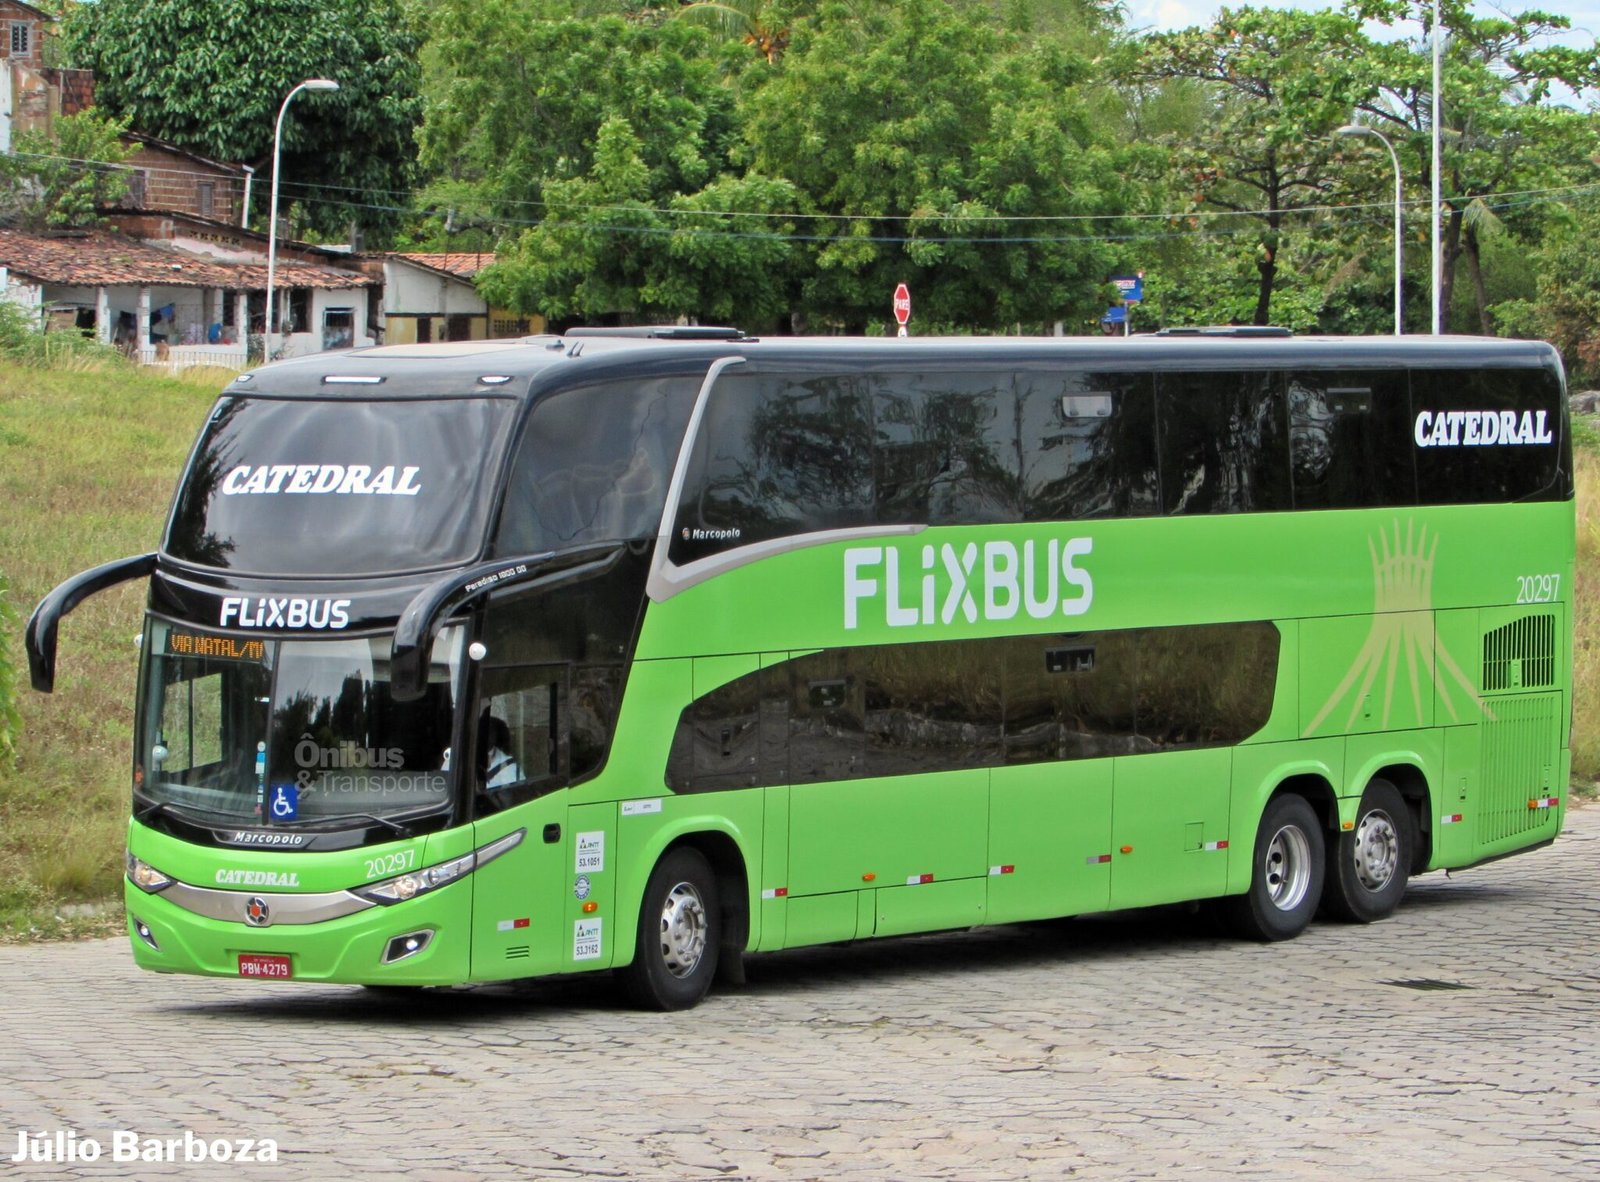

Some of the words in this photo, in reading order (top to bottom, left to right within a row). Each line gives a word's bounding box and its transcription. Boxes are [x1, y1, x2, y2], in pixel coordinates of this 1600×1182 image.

[1414, 411, 1553, 447] CATEDRAL
[222, 465, 422, 496] CATEDRAL
[692, 528, 741, 540] Marcopolo
[465, 574, 499, 592] Paradiso
[1516, 574, 1561, 603] 20297
[171, 634, 192, 653] VIA
[233, 831, 303, 845] Marcopolo
[364, 849, 416, 879] 20297
[578, 857, 601, 868] 53.1051
[215, 868, 300, 887] CATEDRAL
[576, 944, 599, 956] 53.3162
